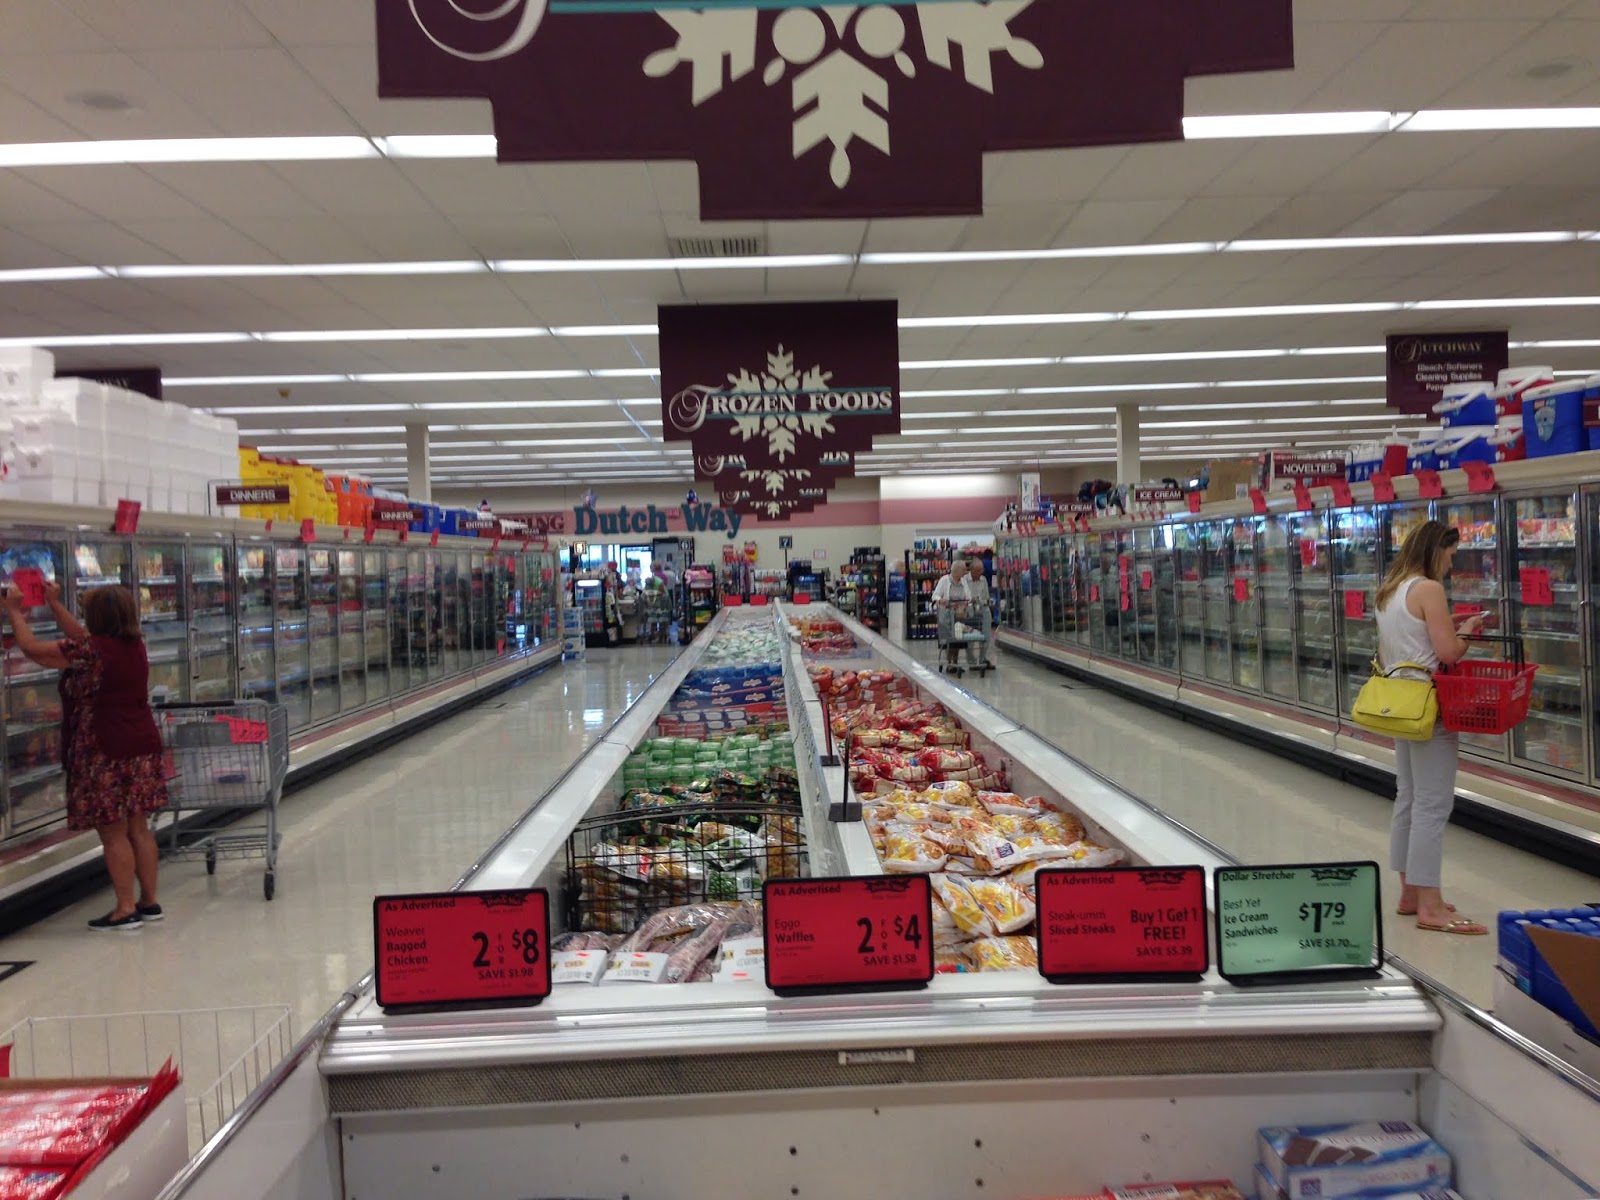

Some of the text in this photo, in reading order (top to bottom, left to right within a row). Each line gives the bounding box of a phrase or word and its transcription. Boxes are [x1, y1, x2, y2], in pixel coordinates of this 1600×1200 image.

[1415, 373, 1448, 382] Cleaning
[668, 384, 893, 432] FROZEN FOODS
[1282, 463, 1337, 474] NOVELTIES
[229, 489, 276, 501] DINNERS
[1139, 490, 1181, 499] ICE CREAM
[1070, 503, 1092, 511] CREAM
[380, 511, 414, 520] DINNERS
[573, 502, 743, 539] Dutch Way
[1047, 875, 1115, 886] As Advertised
[1222, 870, 1296, 882] Dollar Stretcher
[773, 883, 841, 896] As Advertised
[385, 899, 455, 911] As Advertised
[1223, 897, 1261, 911] Best Yet
[1130, 907, 1198, 924] Buy 1 Get 1
[1224, 912, 1269, 924] Ice Cream
[774, 919, 800, 931] Eggo
[1049, 923, 1115, 935] Sliced Steaks
[385, 927, 425, 937] Weaver
[775, 932, 815, 944] Waffles
[857, 917, 875, 954] 2
[894, 914, 922, 950] $4
[1143, 925, 1186, 940] FREE!
[1225, 925, 1279, 939] Sandwiches
[386, 939, 427, 954] Bagged
[472, 931, 490, 968] 2
[512, 928, 540, 964] $8
[1299, 938, 1322, 949] SAVE
[1136, 947, 1162, 957] SAVE
[387, 954, 428, 967] Chicken
[863, 956, 890, 966] SAVE
[478, 968, 534, 980] SAVE $1.98
